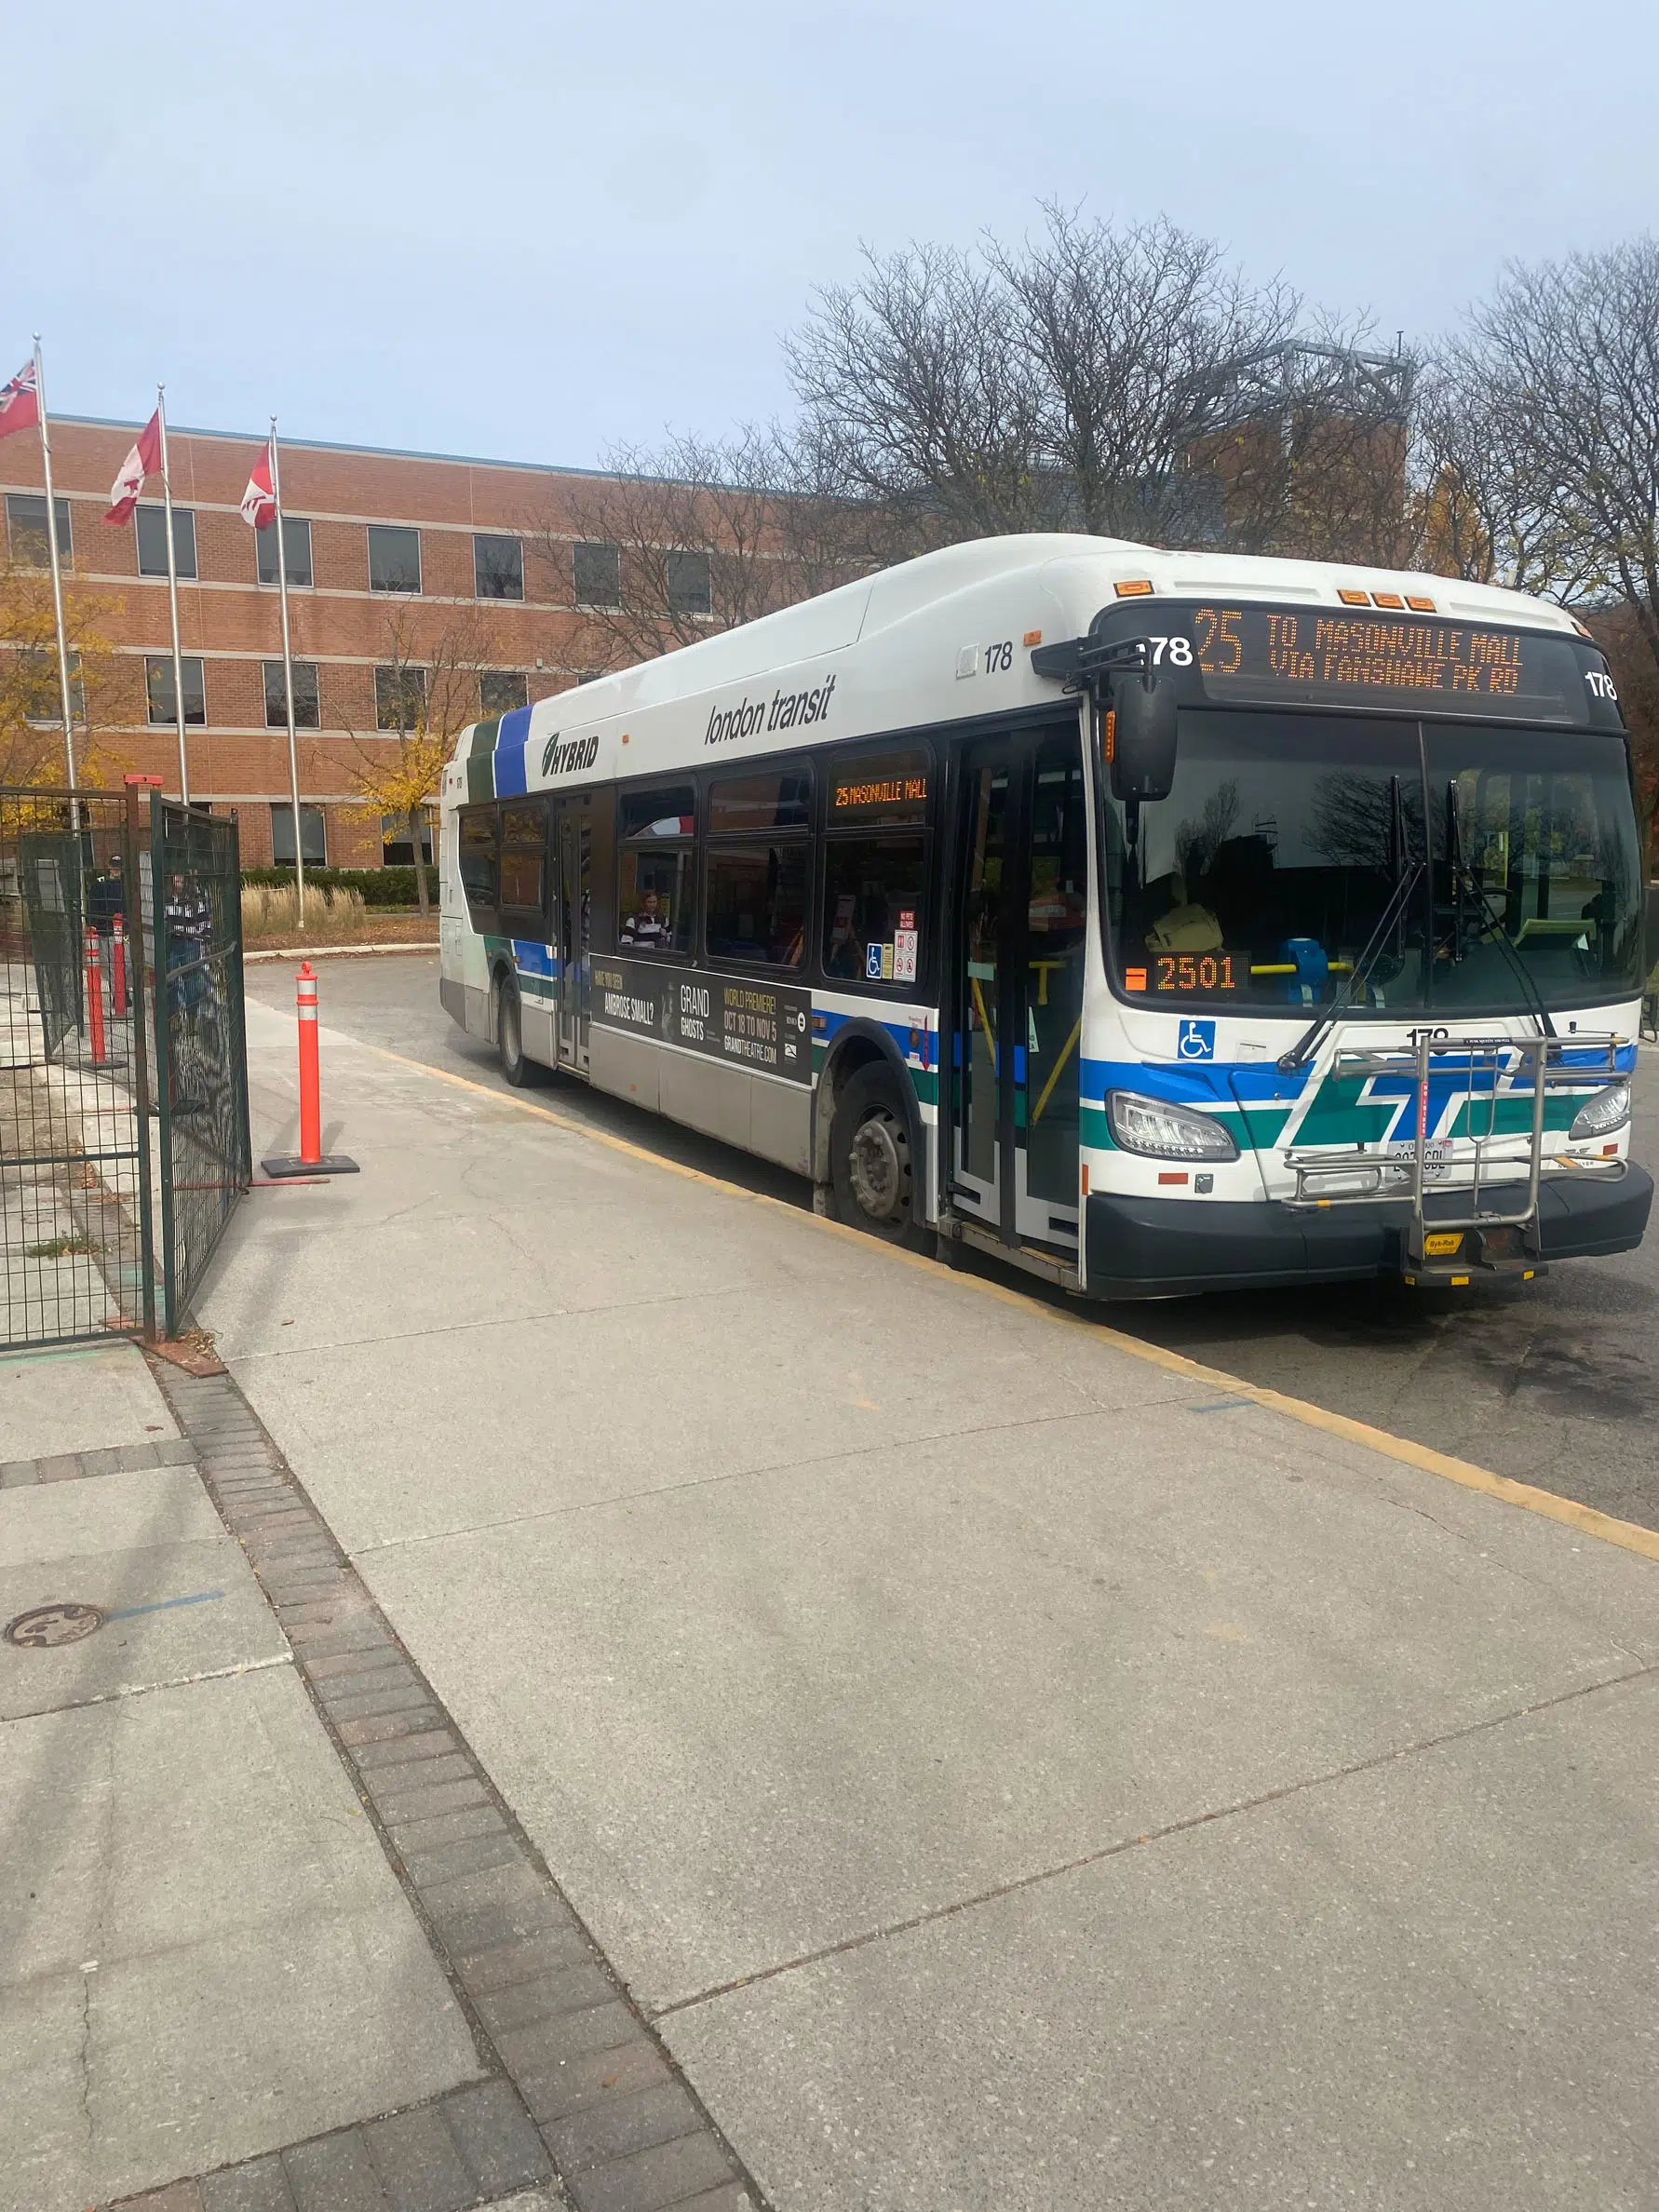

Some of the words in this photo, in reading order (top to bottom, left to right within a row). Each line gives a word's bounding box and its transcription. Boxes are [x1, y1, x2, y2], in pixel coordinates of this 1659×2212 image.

[1194, 608, 1243, 673] 25
[1266, 614, 1298, 647] TO
[1315, 619, 1463, 661] MASONVILLE
[1470, 633, 1524, 666] MALL
[984, 641, 1013, 674] 178
[1270, 650, 1315, 679] VIA
[1324, 654, 1445, 689] FANSHAWE
[1452, 665, 1483, 691] PK
[1490, 668, 1518, 694] RD
[1585, 671, 1618, 701] 178
[704, 697, 766, 746] london
[767, 674, 838, 732] transit
[550, 735, 600, 776] HYBRID
[835, 787, 849, 806] 25
[850, 781, 902, 804] MASONVILLE
[904, 778, 927, 800] MALL
[1157, 956, 1236, 990] 2501
[604, 991, 631, 1020] AMBROSE
[631, 997, 654, 1026] SMALL?
[681, 984, 709, 1018] GRAND
[723, 987, 745, 1008] WORLD
[745, 991, 776, 1016] PREMIERE!
[681, 1017, 705, 1041] GHOSTS
[723, 1010, 736, 1032] OCT
[738, 1013, 746, 1034] 18
[746, 1015, 756, 1037] TO
[756, 1018, 771, 1040] NOV
[771, 1020, 777, 1042] 5
[723, 1035, 777, 1065] GRANDTHEATRE.COM
